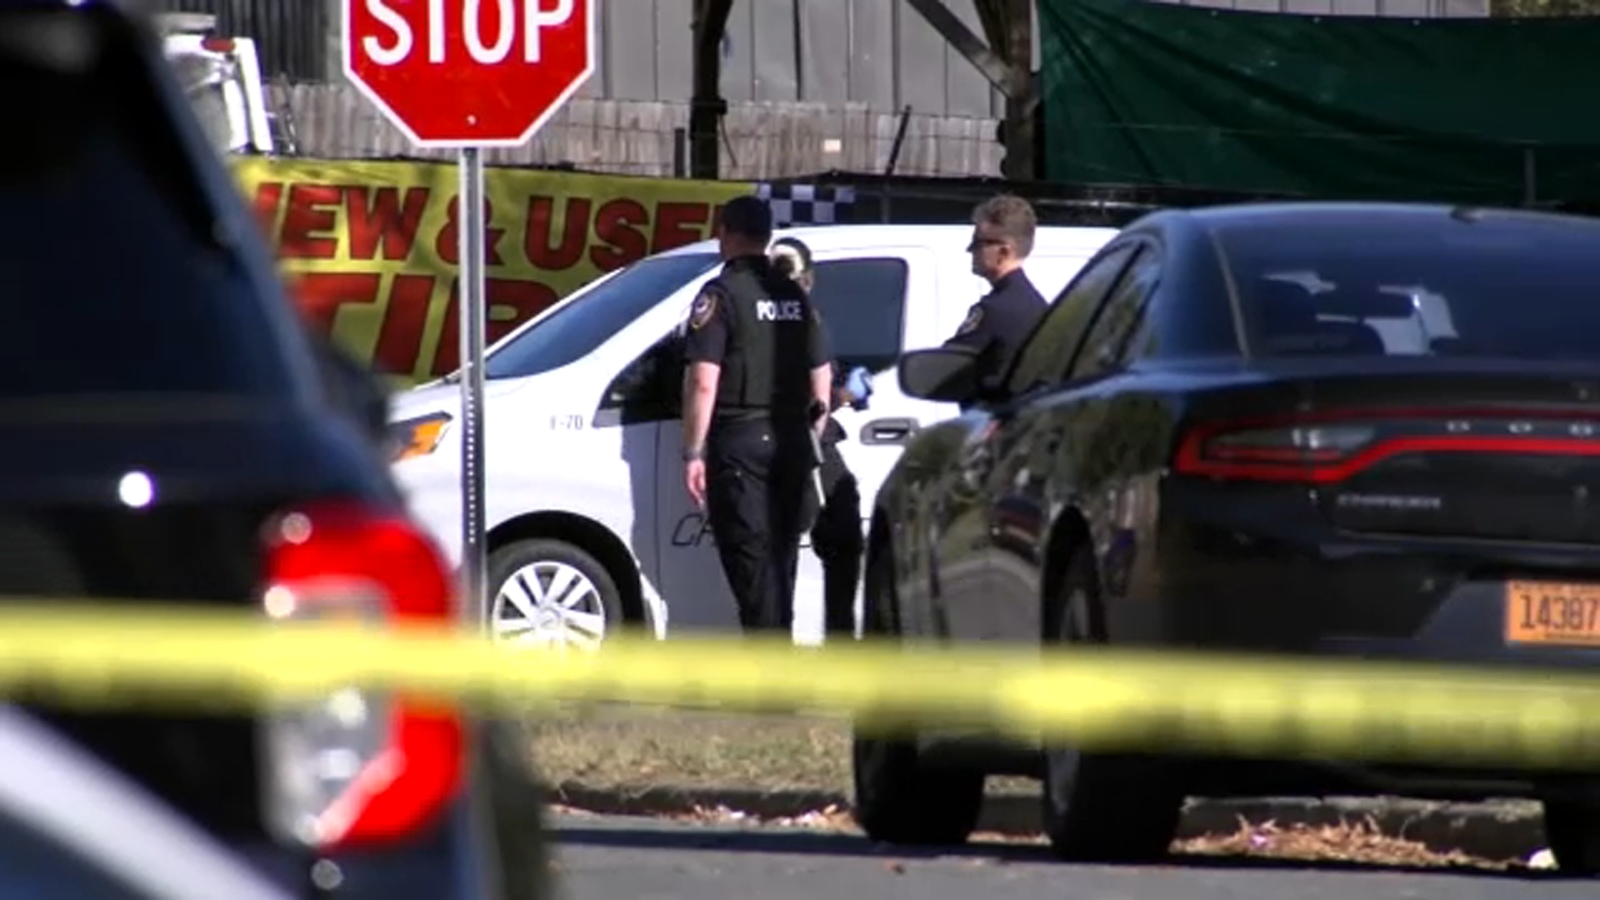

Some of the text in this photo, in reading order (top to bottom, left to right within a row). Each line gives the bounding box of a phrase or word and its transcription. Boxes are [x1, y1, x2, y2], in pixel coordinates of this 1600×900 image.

[362, 0, 574, 65] STOP
[524, 194, 722, 271] USE
[756, 300, 802, 320] POLICE
